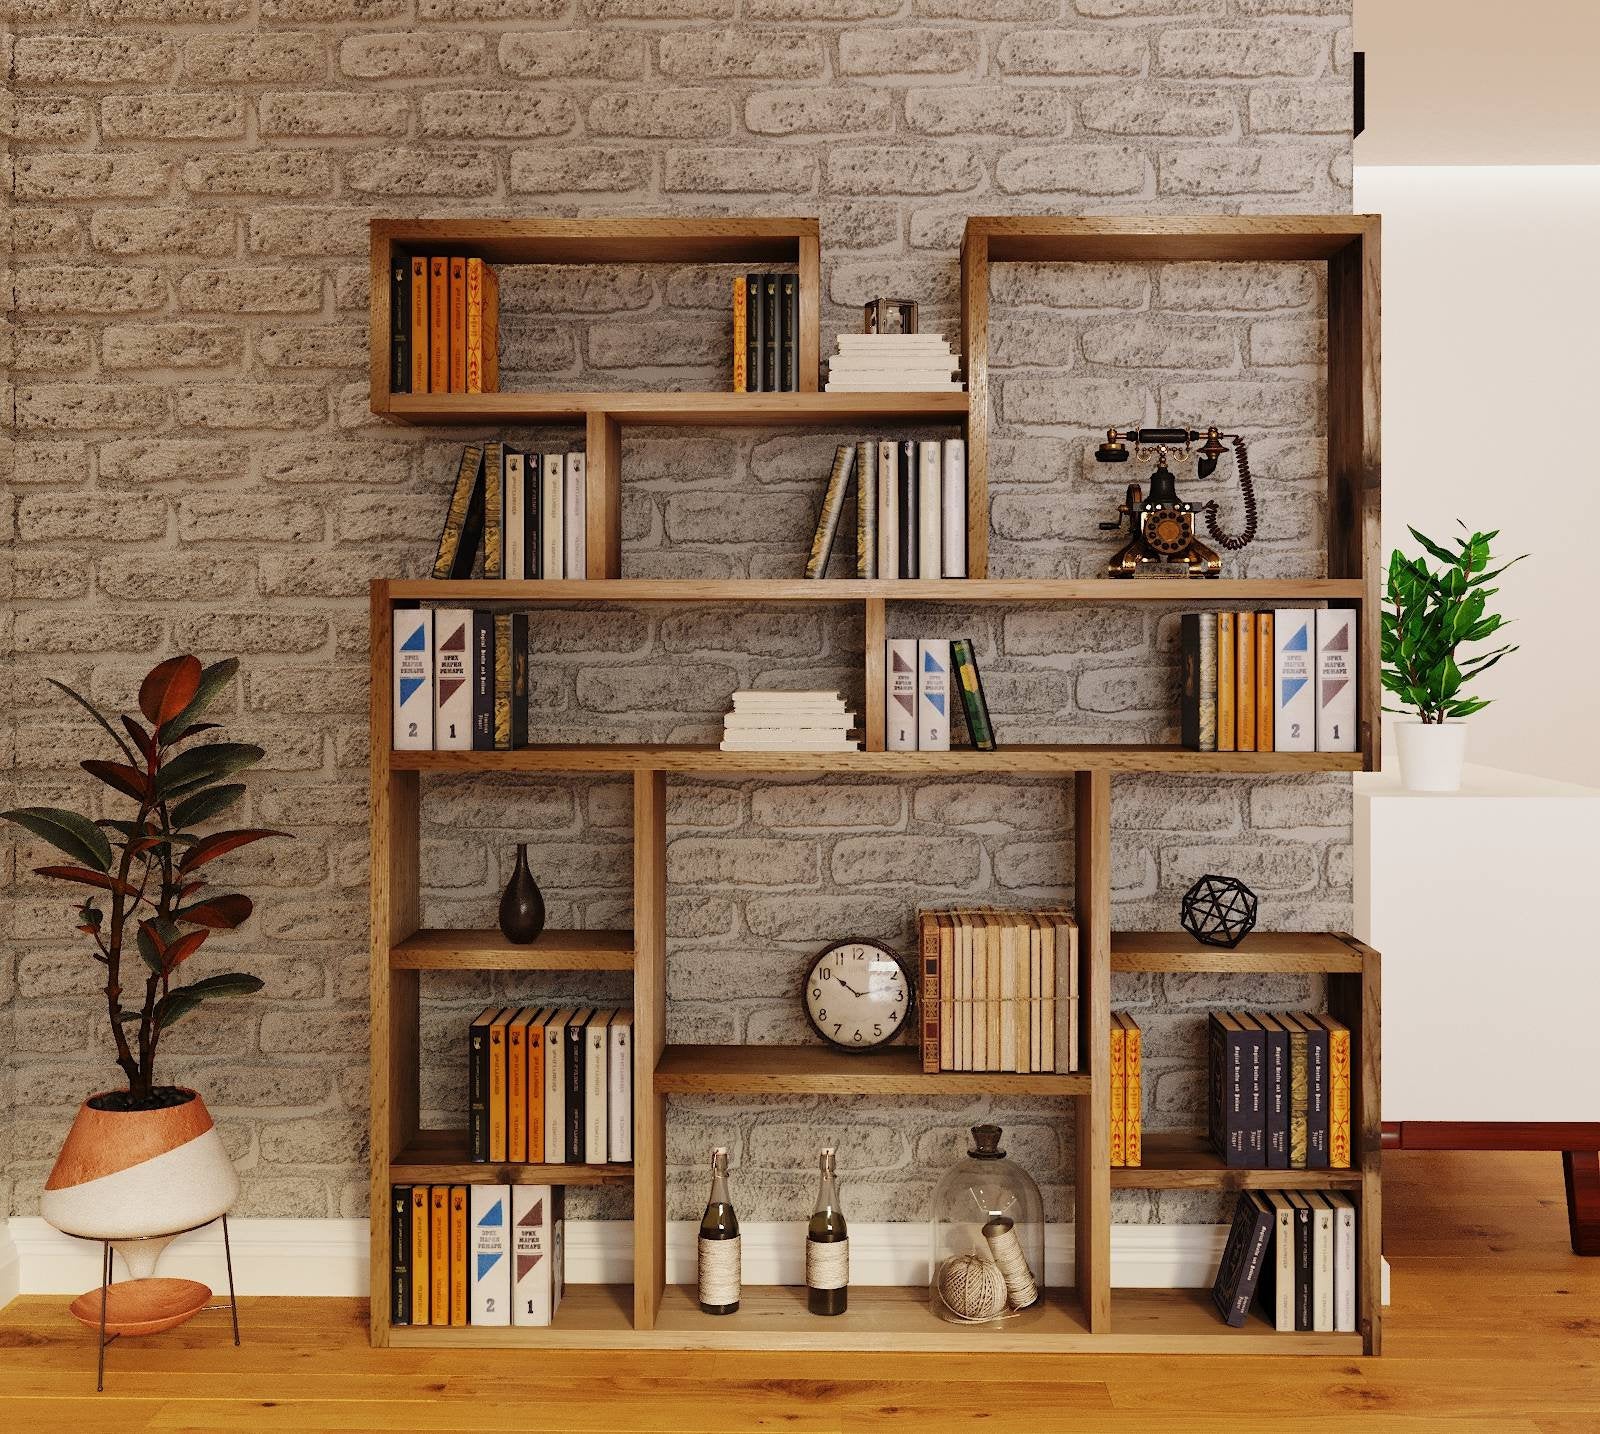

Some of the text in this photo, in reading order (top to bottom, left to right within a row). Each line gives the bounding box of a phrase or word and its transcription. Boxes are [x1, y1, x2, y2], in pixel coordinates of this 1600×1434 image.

[409, 722, 418, 738] 2
[449, 723, 457, 739] 1
[1291, 723, 1300, 739] 2
[1333, 724, 1340, 739] 1
[835, 952, 844, 966] 11
[852, 947, 865, 961] 12
[876, 953, 880, 962] 1
[819, 967, 831, 980] 10
[812, 988, 822, 1000] 9
[894, 989, 904, 1002] 3
[818, 1008, 828, 1022] 8
[888, 1011, 898, 1022] 4
[833, 1023, 842, 1037] 7
[853, 1029, 863, 1042] 6
[873, 1023, 882, 1037] 5
[486, 1298, 495, 1312] 2
[527, 1300, 534, 1314] 1
